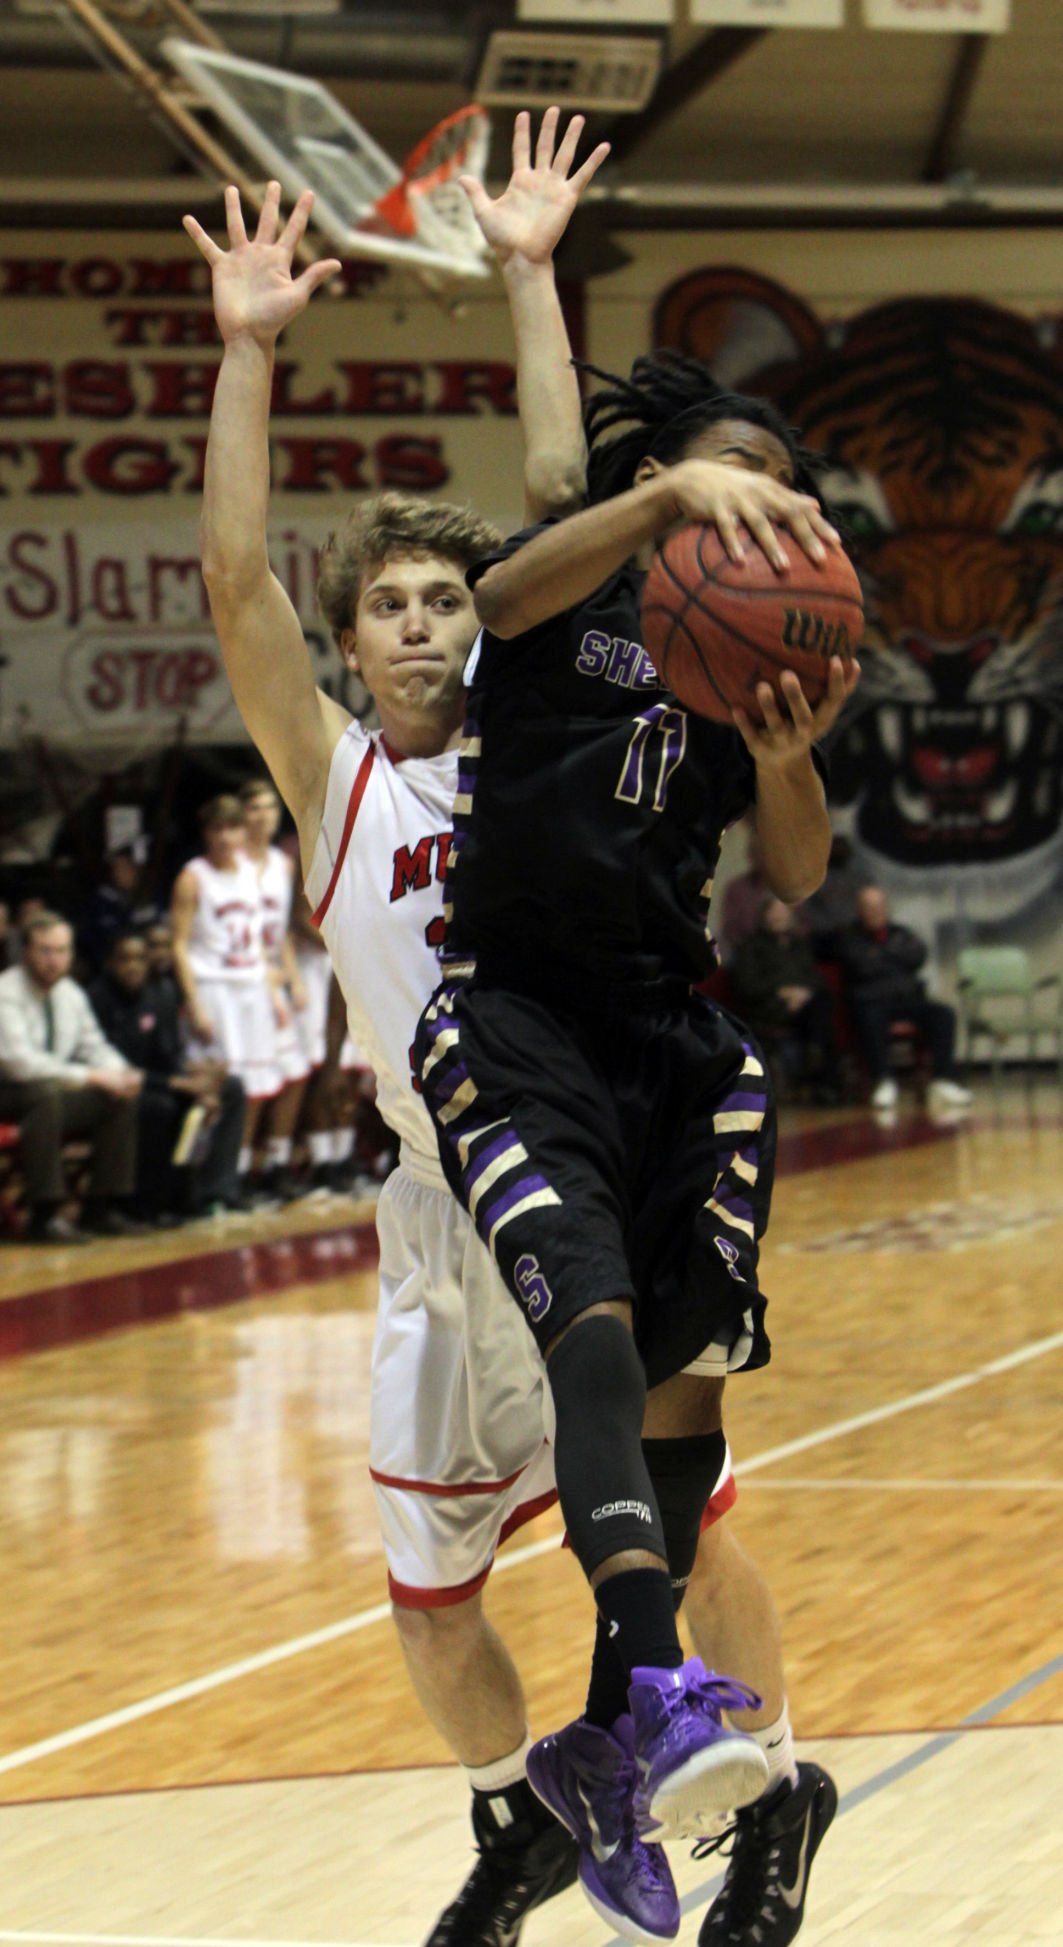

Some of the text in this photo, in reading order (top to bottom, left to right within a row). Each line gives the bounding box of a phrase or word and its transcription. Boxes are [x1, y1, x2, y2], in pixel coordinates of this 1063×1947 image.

[0, 257, 214, 297] HOM
[0, 434, 449, 494] IGRS
[86, 648, 218, 713] STOP
[575, 629, 671, 692] SHE
[614, 703, 688, 813] 11
[513, 1253, 553, 1323] S
